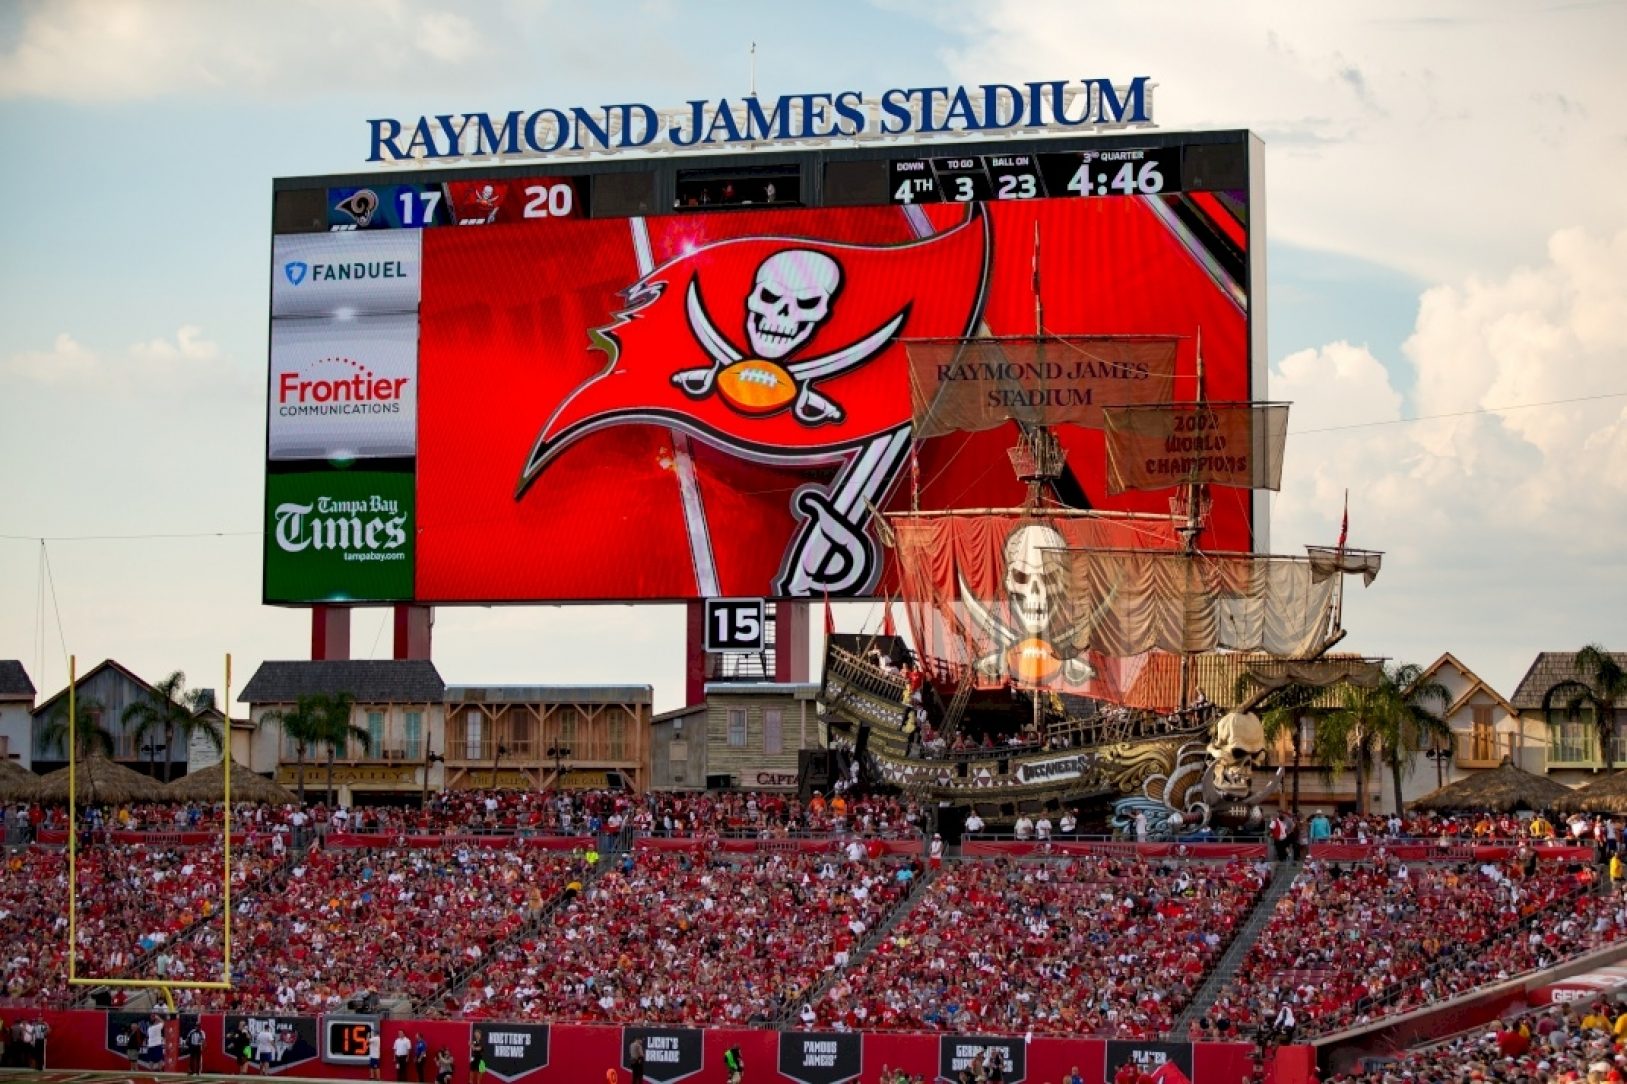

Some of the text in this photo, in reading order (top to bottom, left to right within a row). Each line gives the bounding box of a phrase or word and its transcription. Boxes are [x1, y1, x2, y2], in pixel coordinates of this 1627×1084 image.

[365, 76, 1151, 161] RAYMOND JAMES STADIUM
[897, 163, 924, 171] DOWN
[948, 160, 973, 169] TO GO
[993, 157, 1029, 167] BALL ON
[1101, 152, 1144, 161] QUARTER
[955, 178, 974, 201] 3
[999, 175, 1036, 199] 23
[1067, 161, 1164, 197] 4:46
[524, 184, 573, 218] 20
[894, 178, 933, 204] 4TH
[400, 192, 441, 224] 17
[312, 261, 407, 281] FANDUEL
[936, 361, 1149, 381] RAYMOND JAMES
[280, 372, 407, 403] Frontier
[987, 388, 1093, 407] STADIUM
[279, 403, 400, 416] COMMUNICATIONS
[1174, 415, 1219, 432] 2002
[1145, 456, 1247, 476] CHAMPIONS
[318, 495, 398, 516] Tampa Bay
[275, 502, 407, 552] Times
[344, 551, 405, 561] tampabay.com
[714, 607, 760, 642] 15
[344, 1026, 368, 1055] 15
